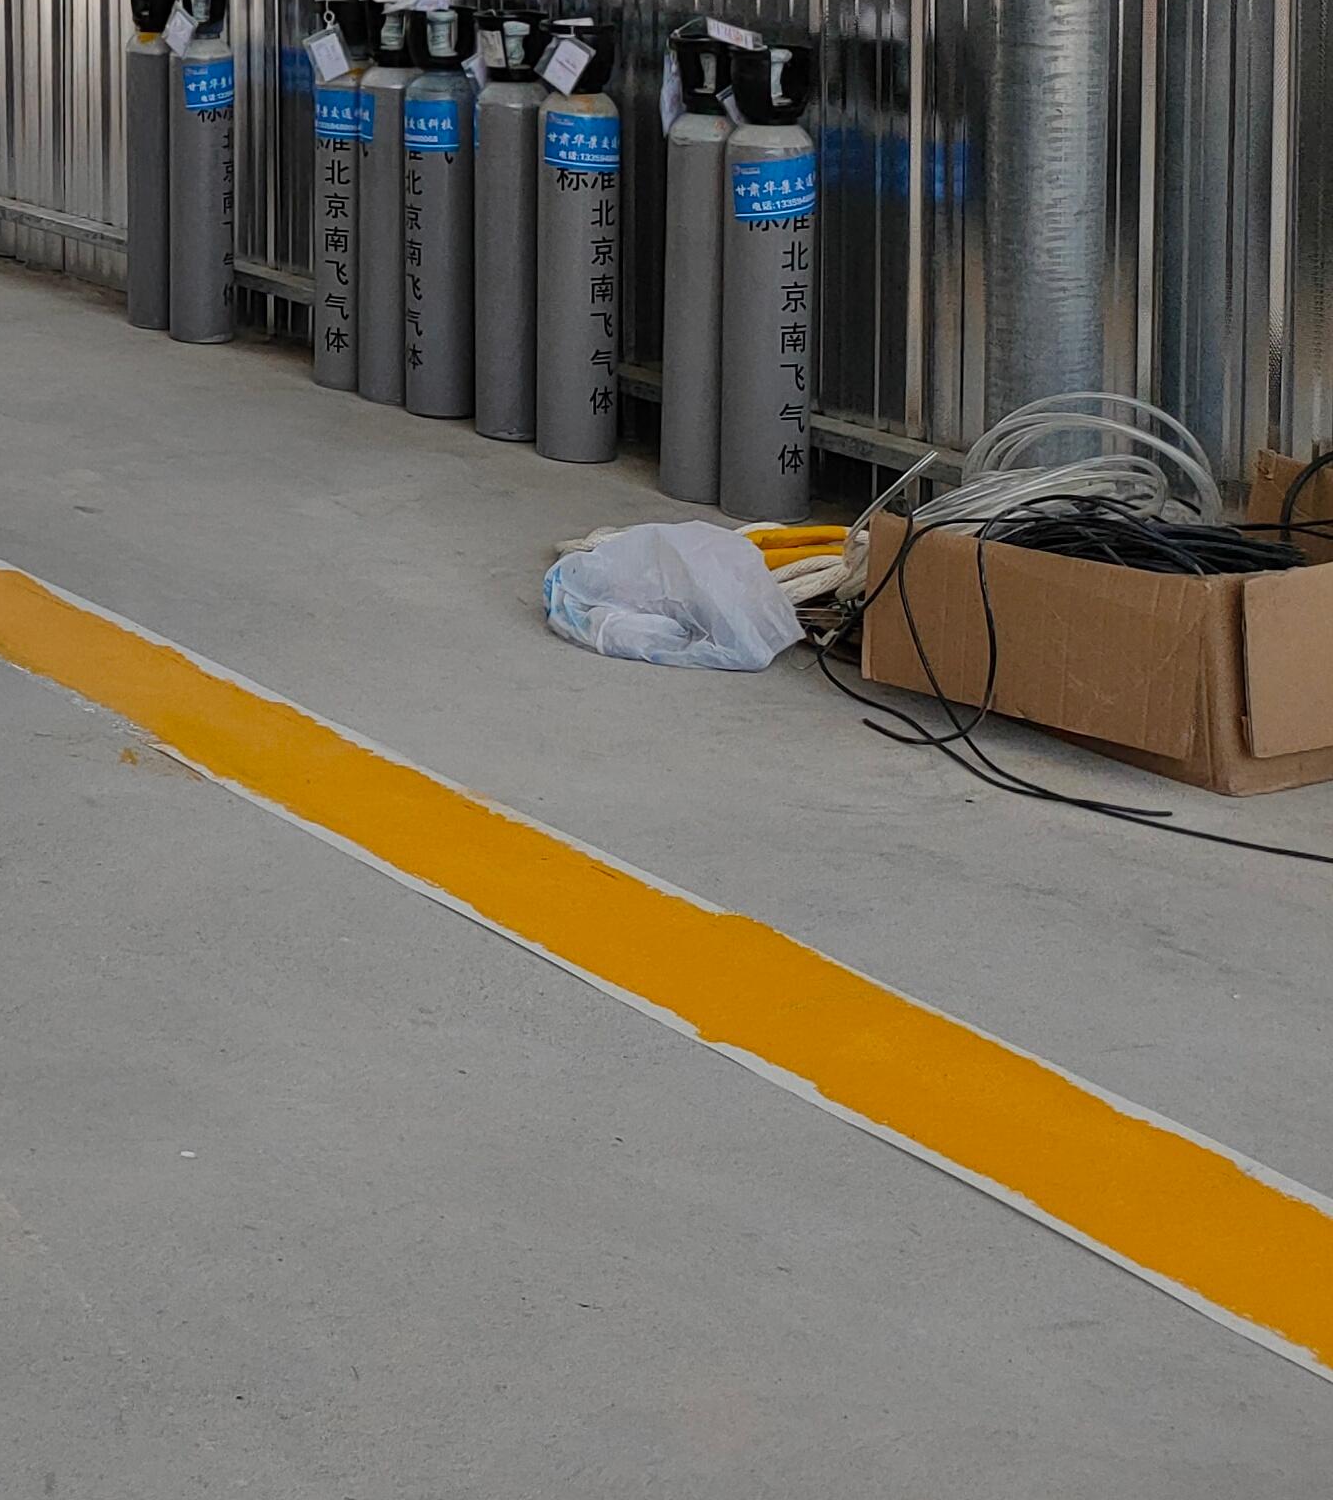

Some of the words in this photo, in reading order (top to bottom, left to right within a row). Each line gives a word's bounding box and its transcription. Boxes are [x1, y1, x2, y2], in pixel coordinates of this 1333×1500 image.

[324, 159, 350, 354] 北京南飞气体
[589, 199, 615, 416] 北京南飞气体
[777, 241, 809, 476] 北京南飞气体
